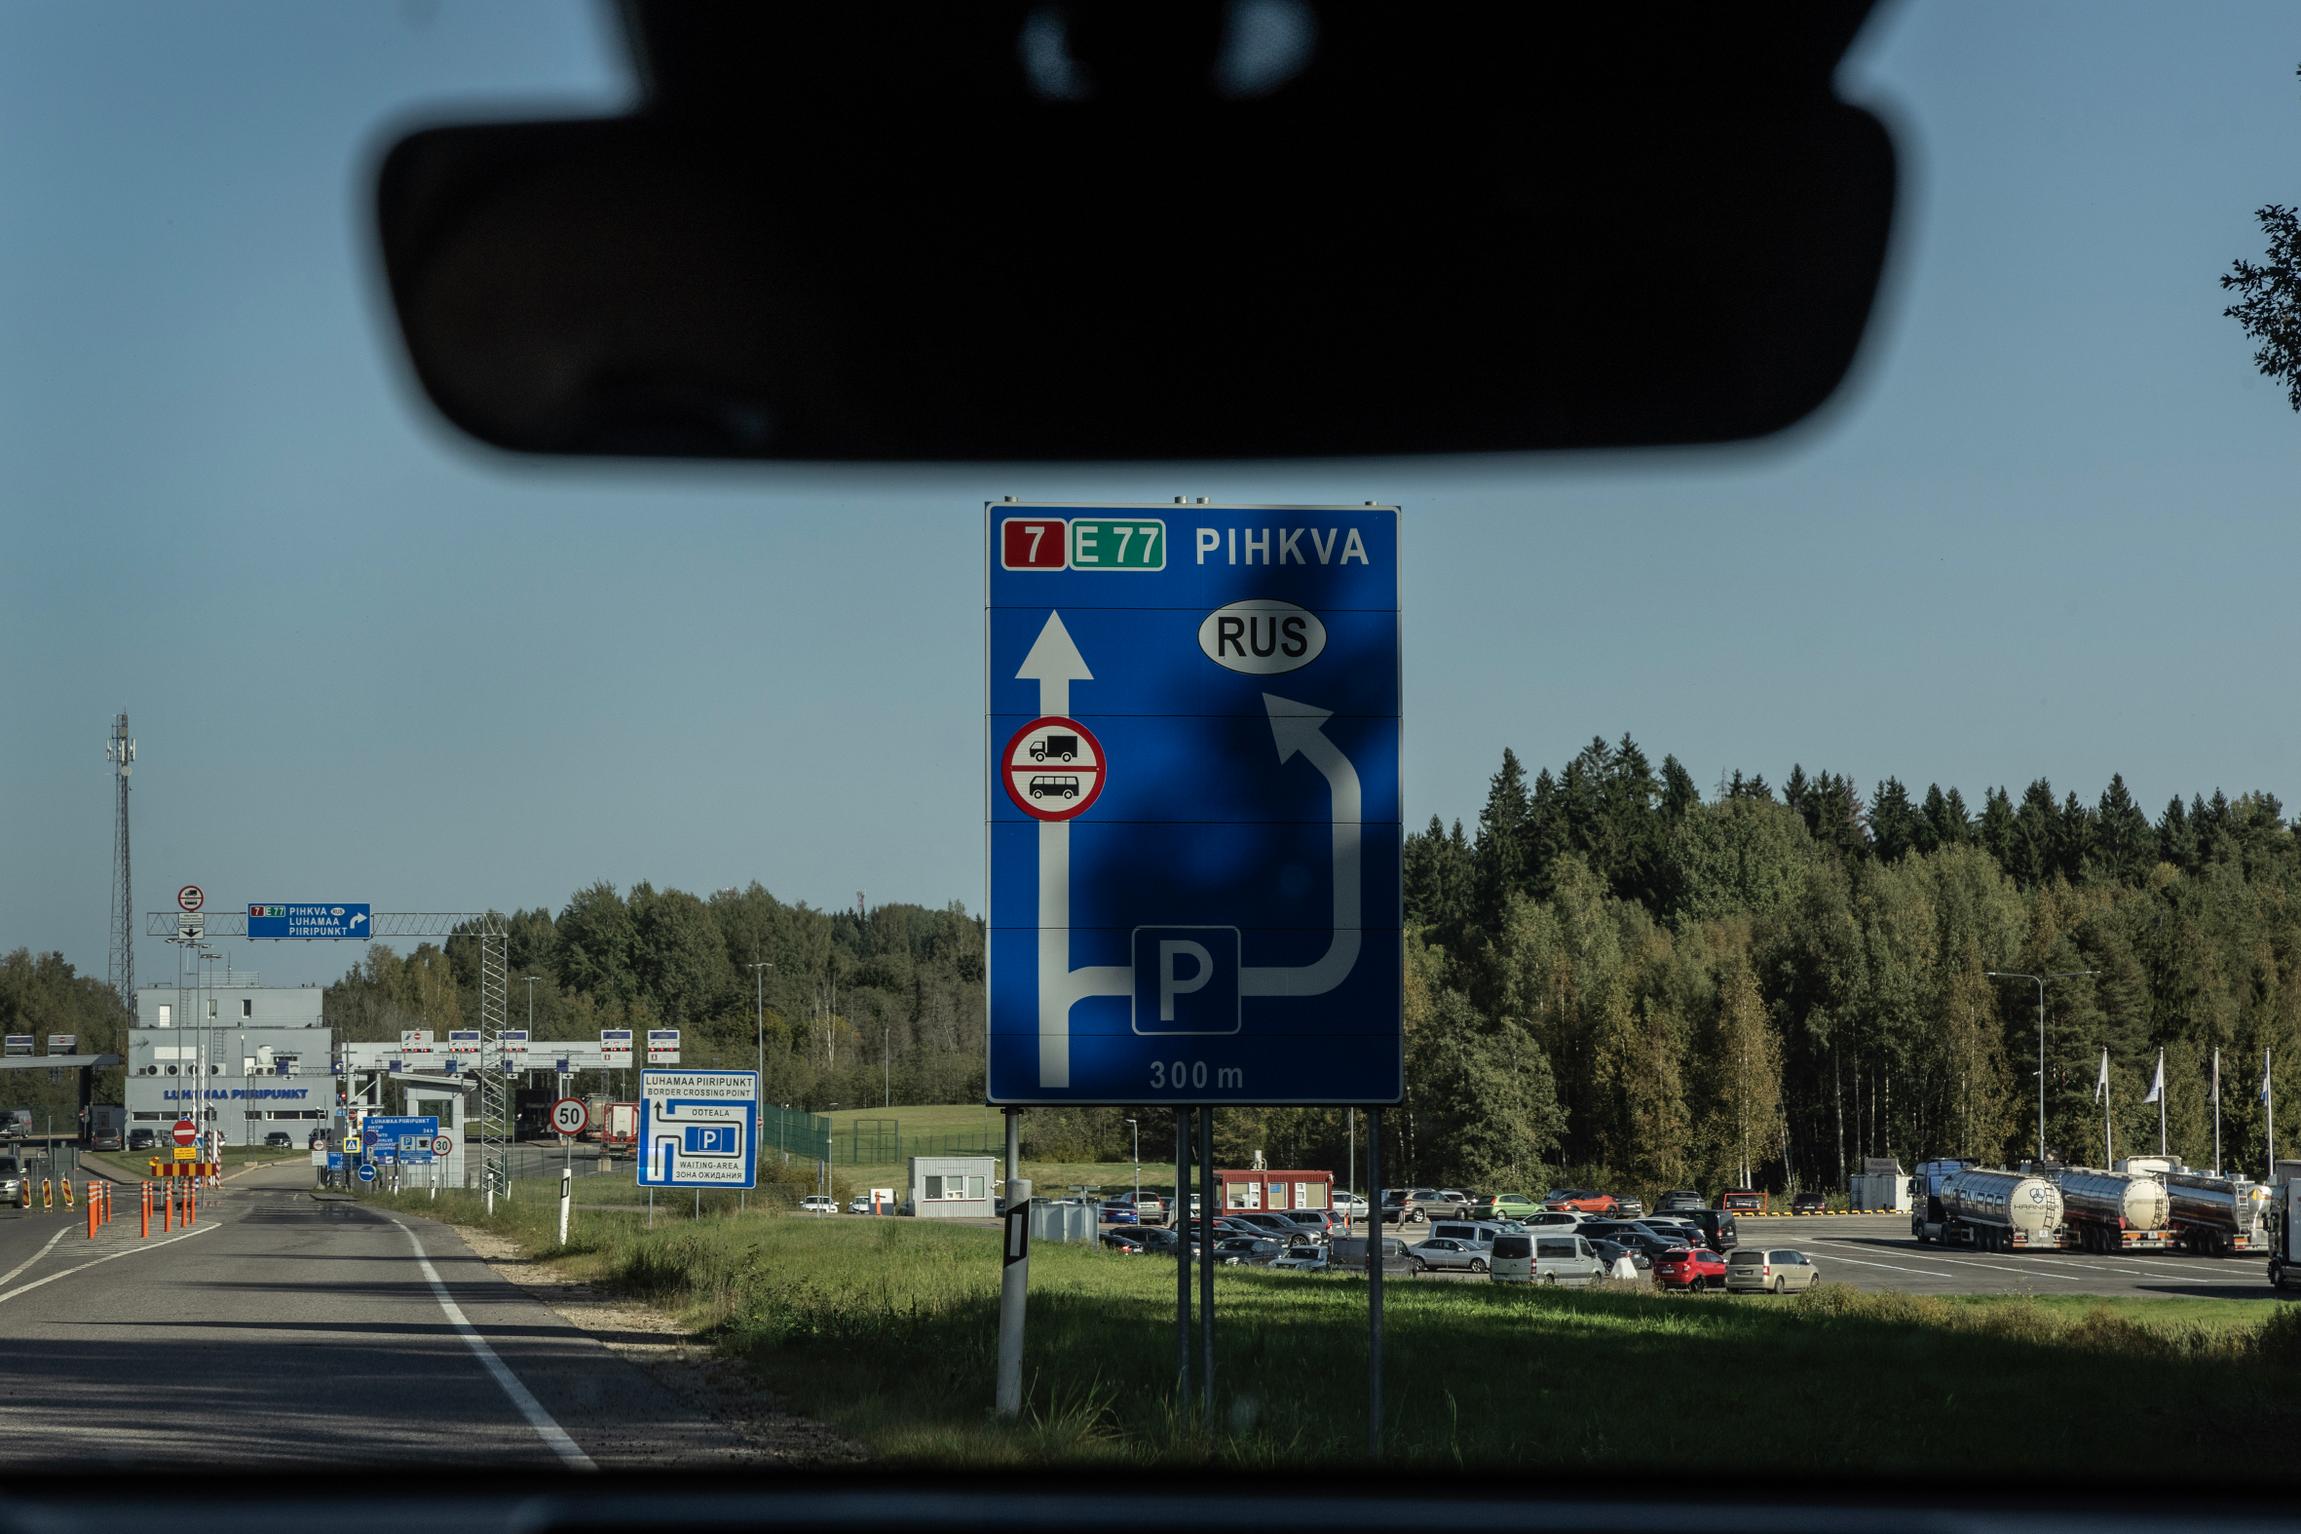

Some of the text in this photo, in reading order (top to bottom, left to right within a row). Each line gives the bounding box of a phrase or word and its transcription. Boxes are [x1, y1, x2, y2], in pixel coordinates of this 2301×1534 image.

[1024, 526, 1045, 563] 7
[1075, 526, 1160, 563] E 77
[1196, 527, 1369, 565] PIHKVA
[1217, 616, 1308, 657] RUS
[254, 907, 260, 915] 7
[267, 907, 284, 915] E 77
[289, 907, 327, 915] PIHKVA
[289, 917, 340, 925] LUHAMAA
[289, 927, 347, 935] PIIRIPUNKT
[1159, 940, 1213, 1021] P
[1150, 1061, 1243, 1089] 300 m
[646, 1077, 752, 1087] LUHAMAA PIIRIPUNKT
[648, 1088, 750, 1097] BORDER CROSSING POINT
[559, 1107, 580, 1125] 50
[692, 1109, 730, 1117] OOTEALA
[703, 1131, 717, 1149] P
[436, 1140, 448, 1151] 30
[680, 1161, 739, 1170] WAITING-AREA
[676, 1171, 742, 1180] ЗОНА ОЖИДАНИЯ
